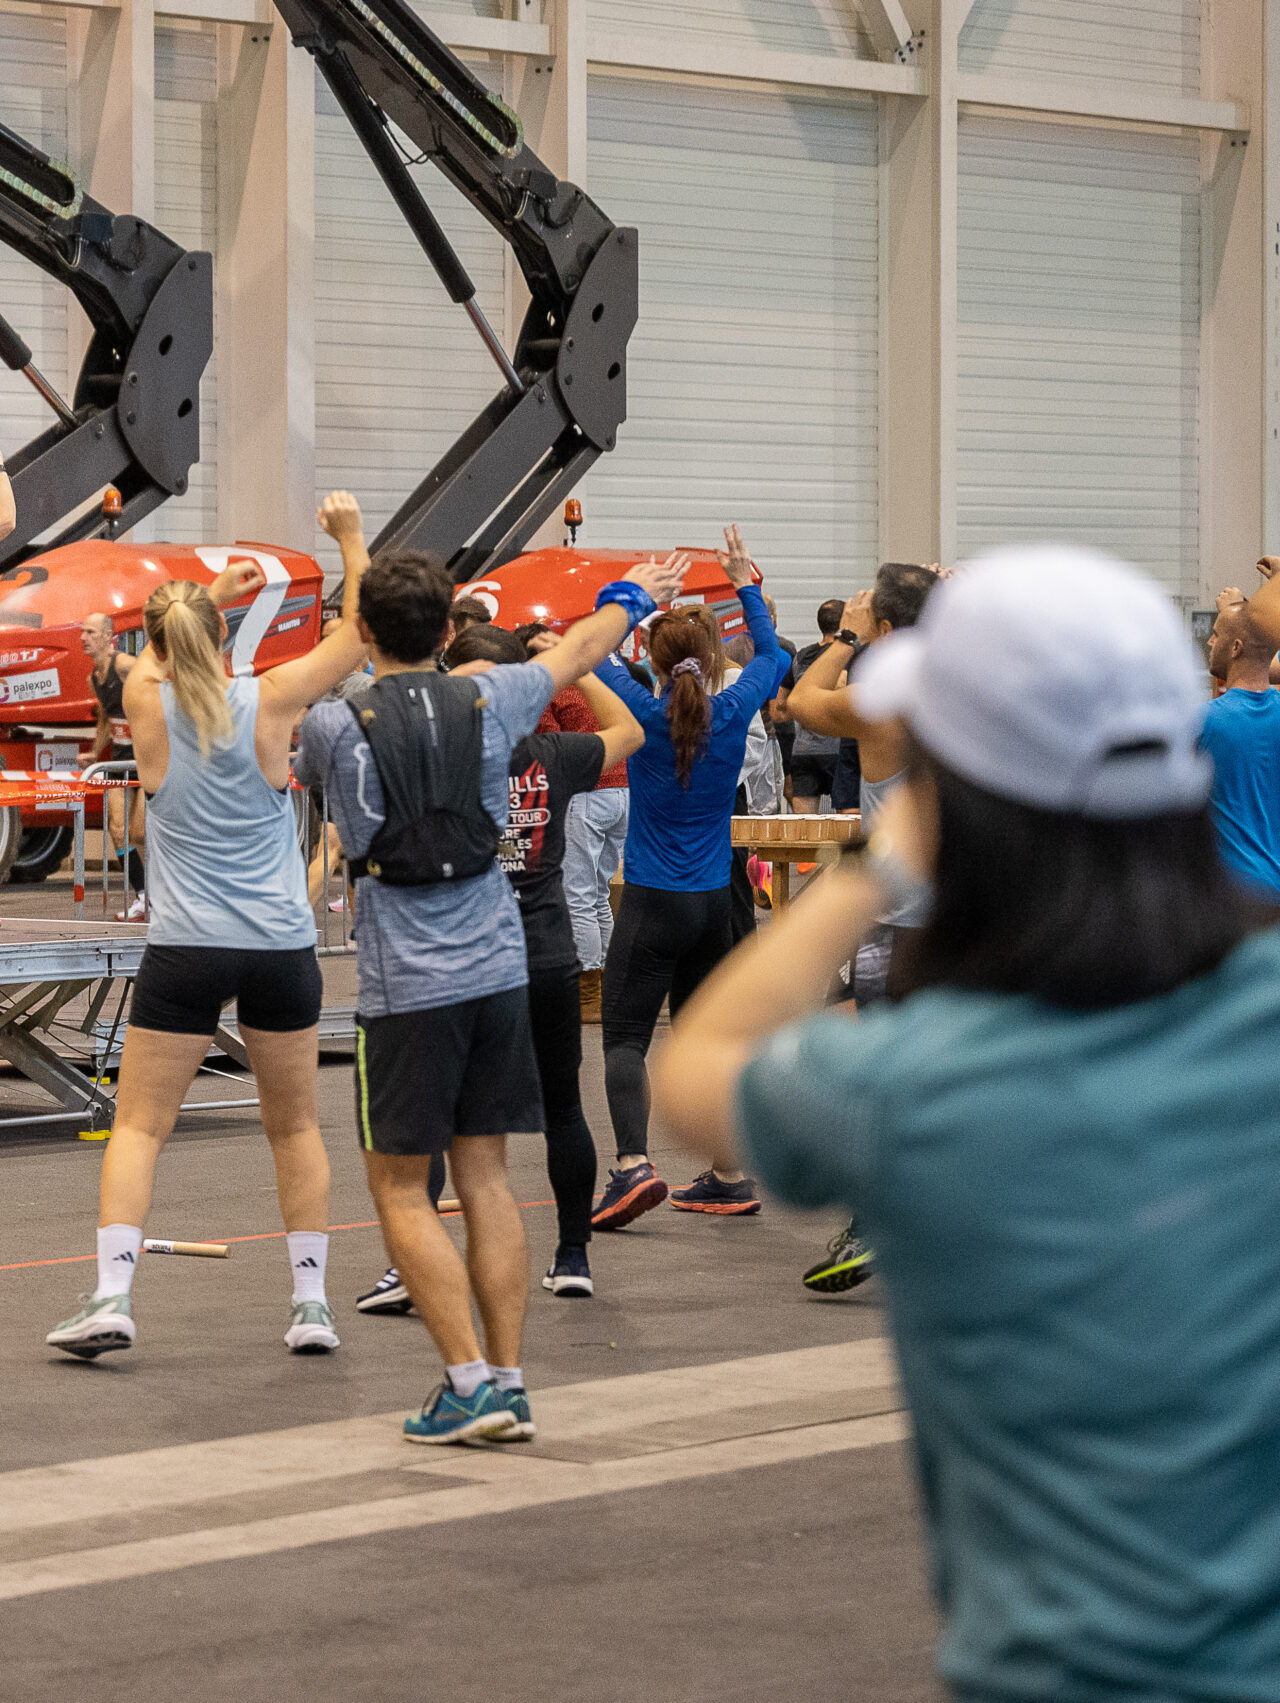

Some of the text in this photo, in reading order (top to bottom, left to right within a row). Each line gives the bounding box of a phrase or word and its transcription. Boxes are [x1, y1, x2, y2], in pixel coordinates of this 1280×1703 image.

[13, 680, 52, 695] palexpo
[508, 774, 550, 793] ILLS
[509, 793, 522, 809] 3
[510, 812, 543, 824] TOUR
[499, 828, 522, 840] RE
[500, 861, 526, 873] ONA
